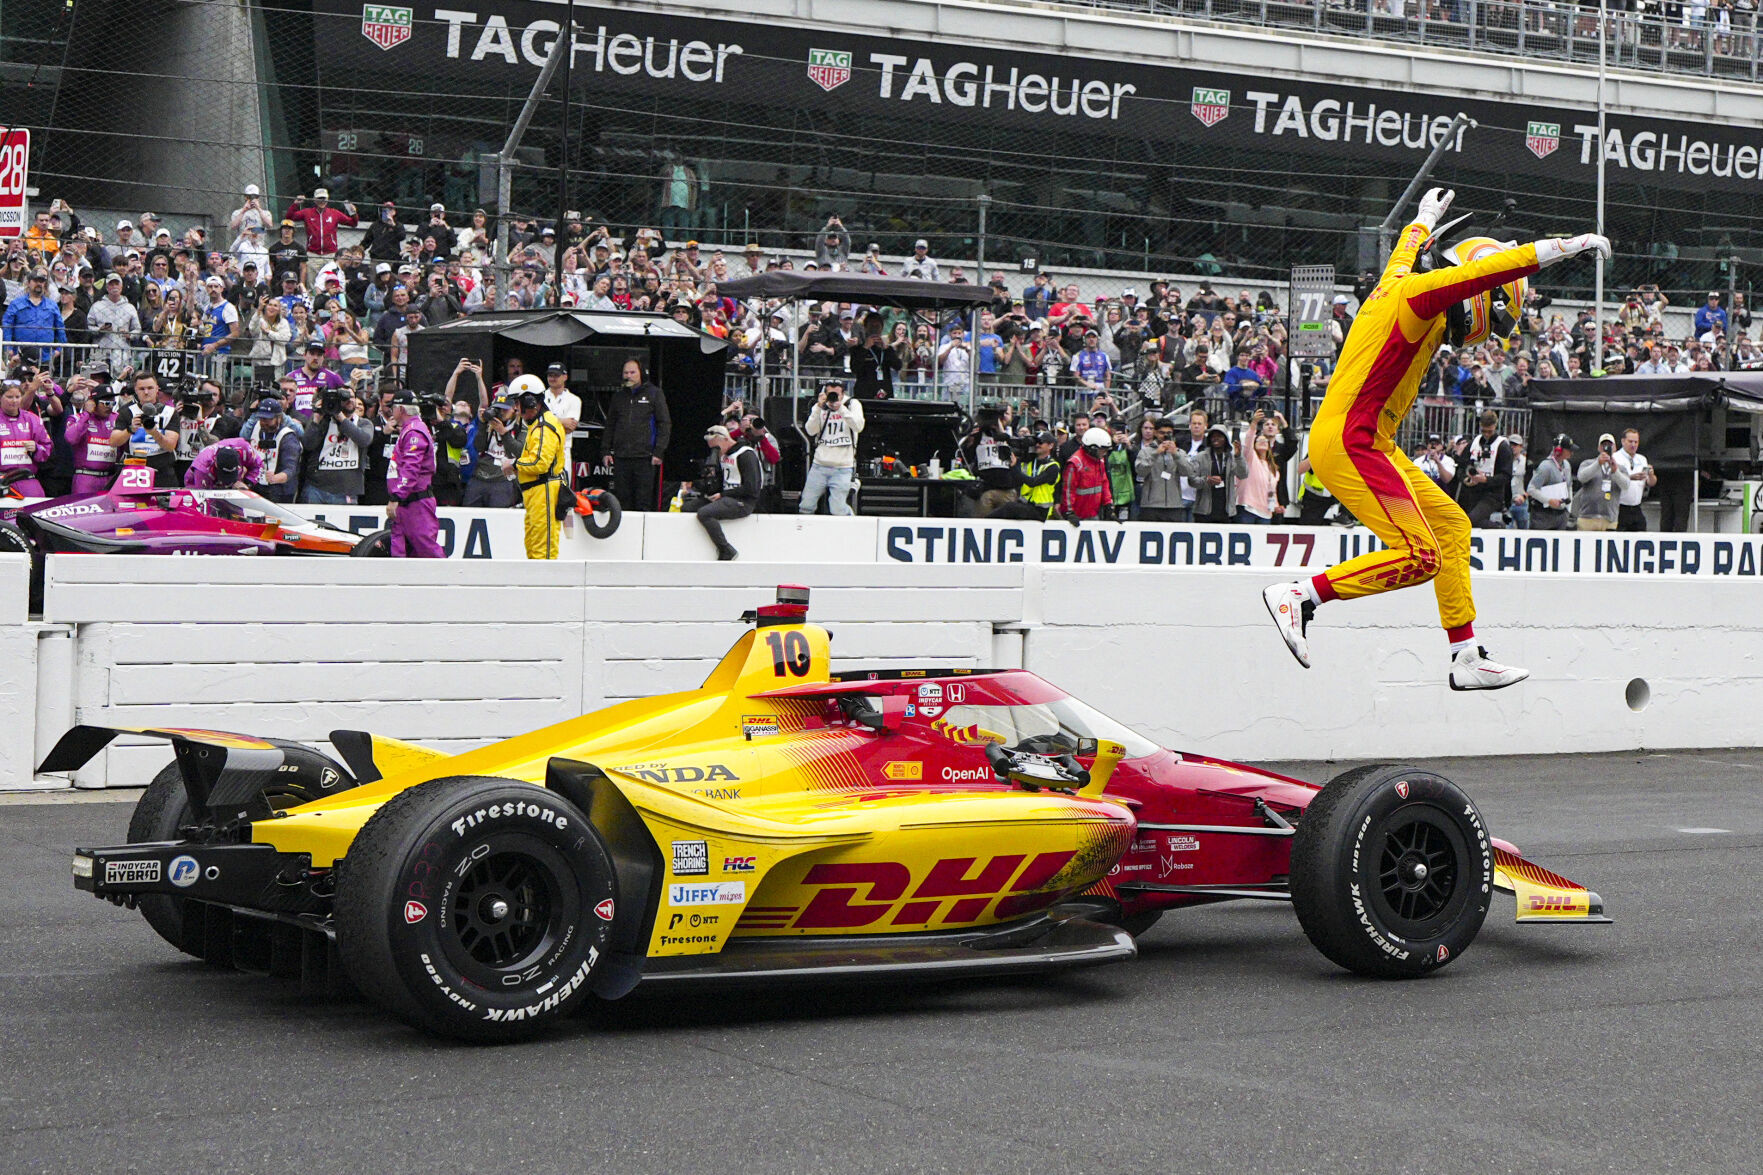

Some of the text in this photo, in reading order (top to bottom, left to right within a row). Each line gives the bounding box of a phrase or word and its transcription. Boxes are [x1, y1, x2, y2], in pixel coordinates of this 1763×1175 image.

[367, 7, 409, 23] TAG
[365, 24, 410, 48] HEUER
[813, 51, 849, 67] TAG
[809, 67, 849, 89] HEUER
[1196, 89, 1227, 105] TAG
[1192, 105, 1227, 124] HEUER
[1531, 124, 1558, 137] TAG
[1527, 137, 1558, 156] HEUER
[0, 144, 26, 195] 28
[1023, 258, 1036, 269] 15
[1300, 292, 1325, 321] 77
[157, 358, 180, 378] 42
[320, 460, 357, 469] PHOTO
[122, 468, 151, 488] 28
[1265, 533, 1316, 567] 77
[1713, 541, 1763, 577] RA
[765, 630, 811, 678] 10
[622, 764, 741, 784] NDA
[941, 766, 989, 783] OpenAI
[451, 801, 568, 838] Firestone
[1168, 836, 1195, 844] LINCOLN
[1352, 815, 1372, 874] INDY 500
[1463, 804, 1491, 894] Firestone
[672, 843, 706, 858] TRENCH
[117, 862, 158, 870] INDYCAR
[672, 857, 707, 870] SHORING
[723, 856, 757, 871] HRC
[672, 886, 743, 903] JIFFY mixes
[790, 850, 1081, 928] DHL
[440, 880, 453, 929] RACING
[1528, 895, 1577, 911] DHL
[702, 915, 720, 925] NTT
[1350, 882, 1410, 961] FIREHAWK
[548, 924, 574, 966] RACING
[660, 933, 718, 947] Firestone
[420, 953, 477, 1011] INDY 500
[482, 945, 600, 1022] FIREHAWK
